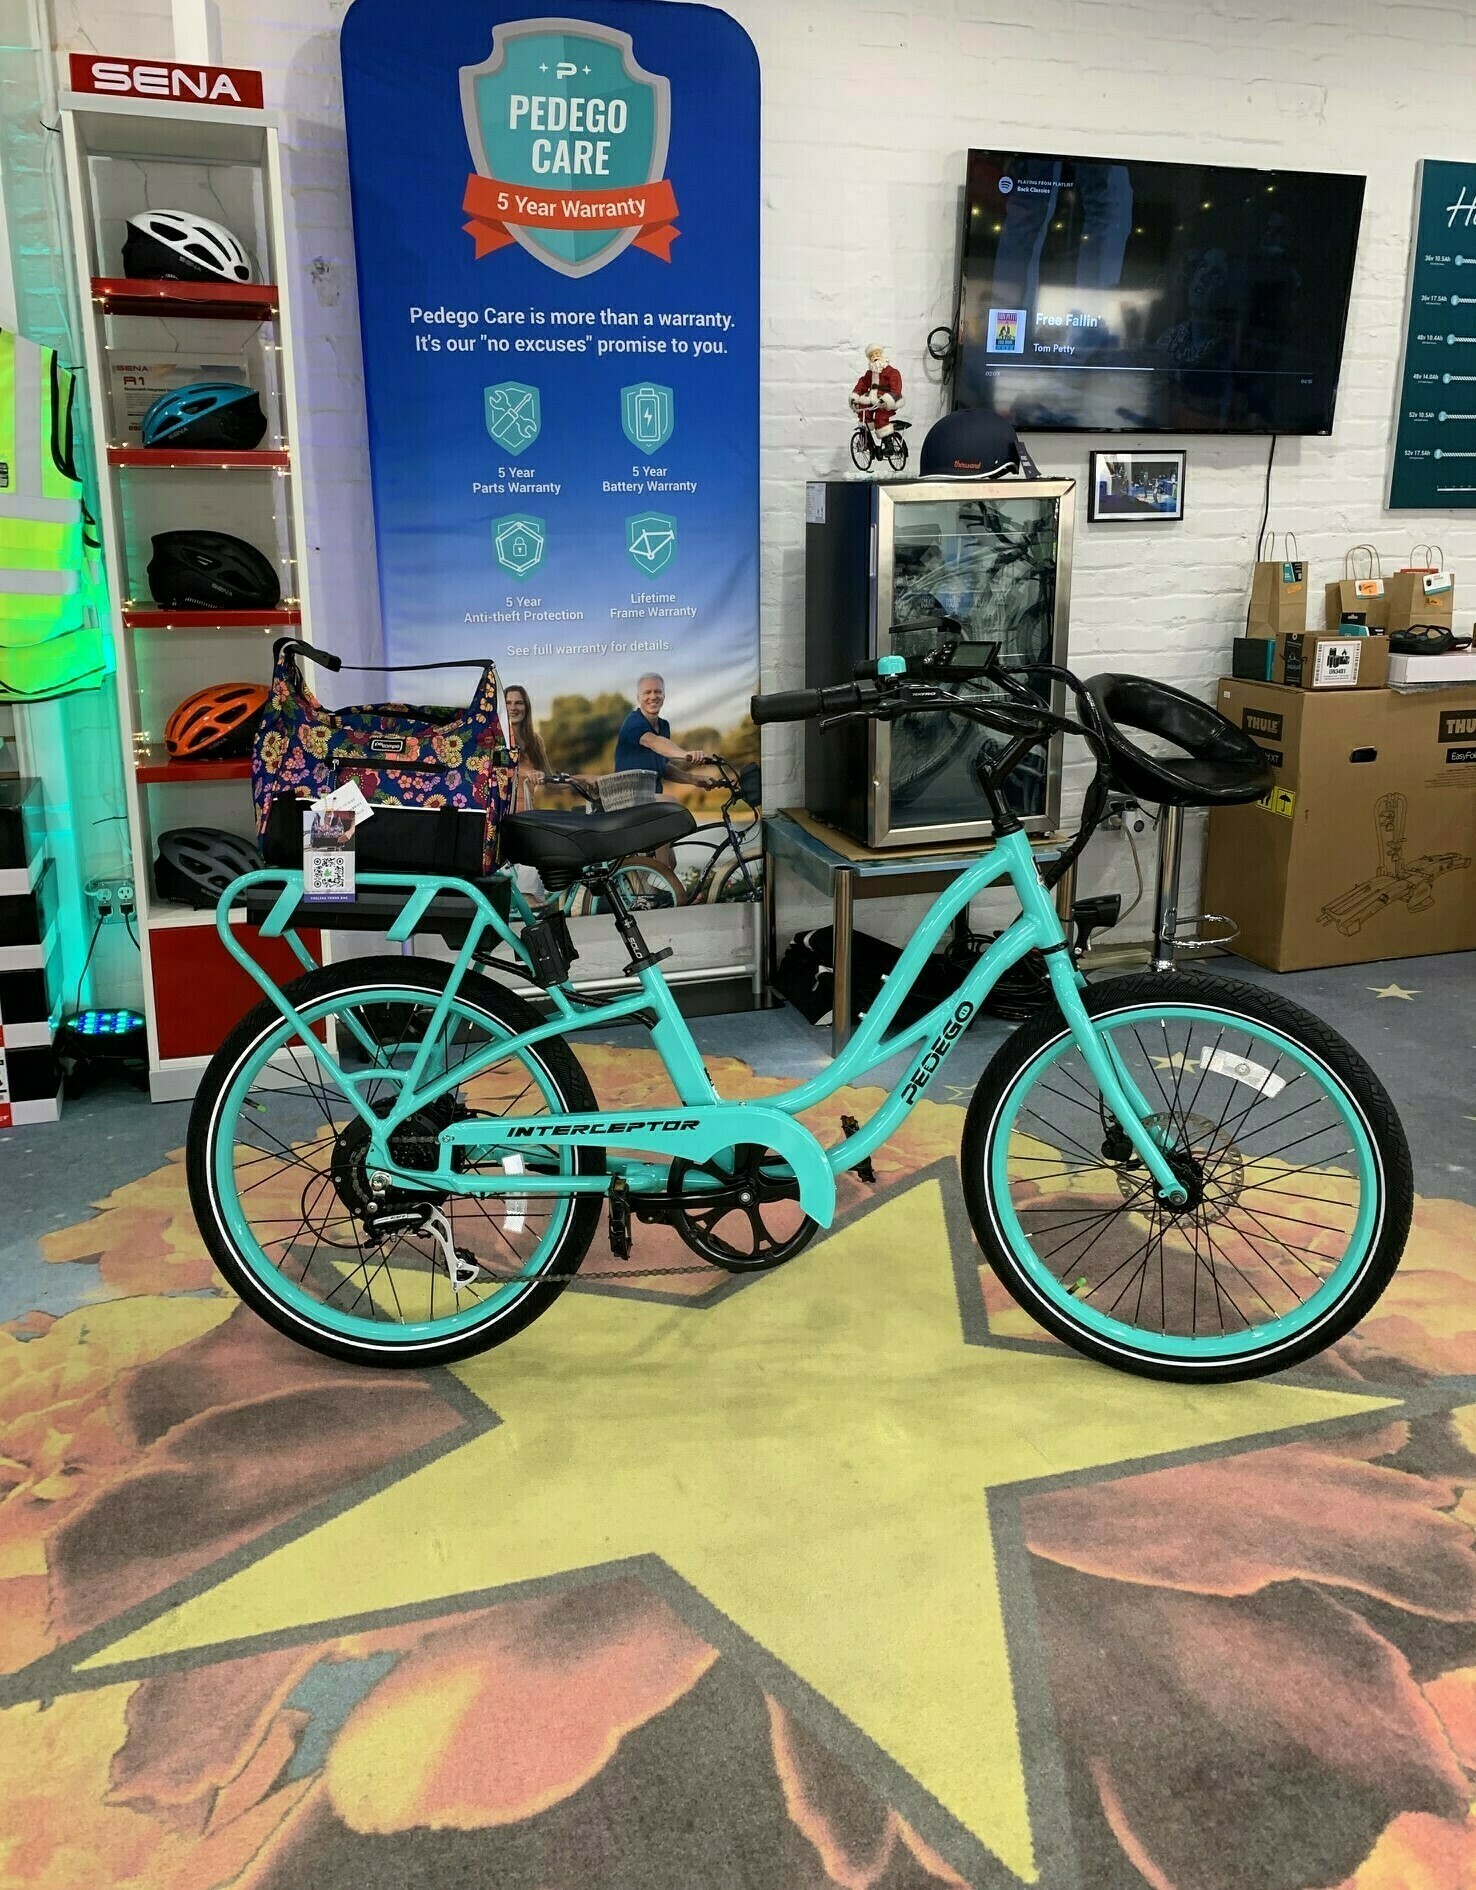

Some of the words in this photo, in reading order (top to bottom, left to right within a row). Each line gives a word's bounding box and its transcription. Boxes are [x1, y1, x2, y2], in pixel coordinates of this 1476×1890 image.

[91, 62, 242, 102] SENA
[509, 94, 628, 134] PEDEGO
[532, 138, 611, 175] CARE
[497, 192, 509, 210] 5
[514, 195, 556, 217] Year
[561, 198, 646, 218] Warranty
[409, 306, 479, 328] Pedego
[484, 307, 526, 324] Care
[530, 307, 546, 324] is
[550, 311, 596, 325] more
[600, 308, 638, 326] than
[643, 313, 653, 326] a
[658, 312, 735, 331] warranty.
[1035, 312, 1061, 326] Free
[1065, 314, 1102, 327] Fallin'
[415, 334, 442, 352] It's
[446, 338, 476, 352] our
[480, 334, 510, 352] "no
[514, 335, 593, 353] excuses"
[597, 335, 667, 356] promise
[671, 338, 689, 353] to
[693, 340, 728, 357] you.
[1033, 343, 1051, 353] Tom
[1053, 344, 1075, 355] Petty
[116, 364, 149, 372] SENA
[168, 427, 189, 440] SENA
[498, 467, 506, 478] 5
[508, 467, 535, 478] Year
[632, 466, 640, 477] 5
[642, 466, 668, 477] Year
[472, 482, 505, 493] Parts
[507, 482, 561, 495] Warranty
[602, 481, 644, 494] Battery
[647, 480, 698, 493] Warranty
[505, 596, 513, 607] 5
[516, 596, 542, 607] Year
[630, 592, 676, 604] Lifetime
[464, 610, 521, 623] Anti-theft
[524, 609, 584, 621] Protection
[610, 607, 645, 619] Frame
[647, 606, 698, 618] Warranty
[507, 644, 530, 657] See
[532, 642, 552, 655] full
[556, 641, 608, 656] warranty
[611, 640, 627, 652] for
[630, 639, 673, 652] details.
[1246, 715, 1279, 734] THULE
[627, 937, 643, 959] SOLO
[901, 1001, 974, 1106] PEDEGO
[506, 1120, 700, 1138] INTERCEPTOR
